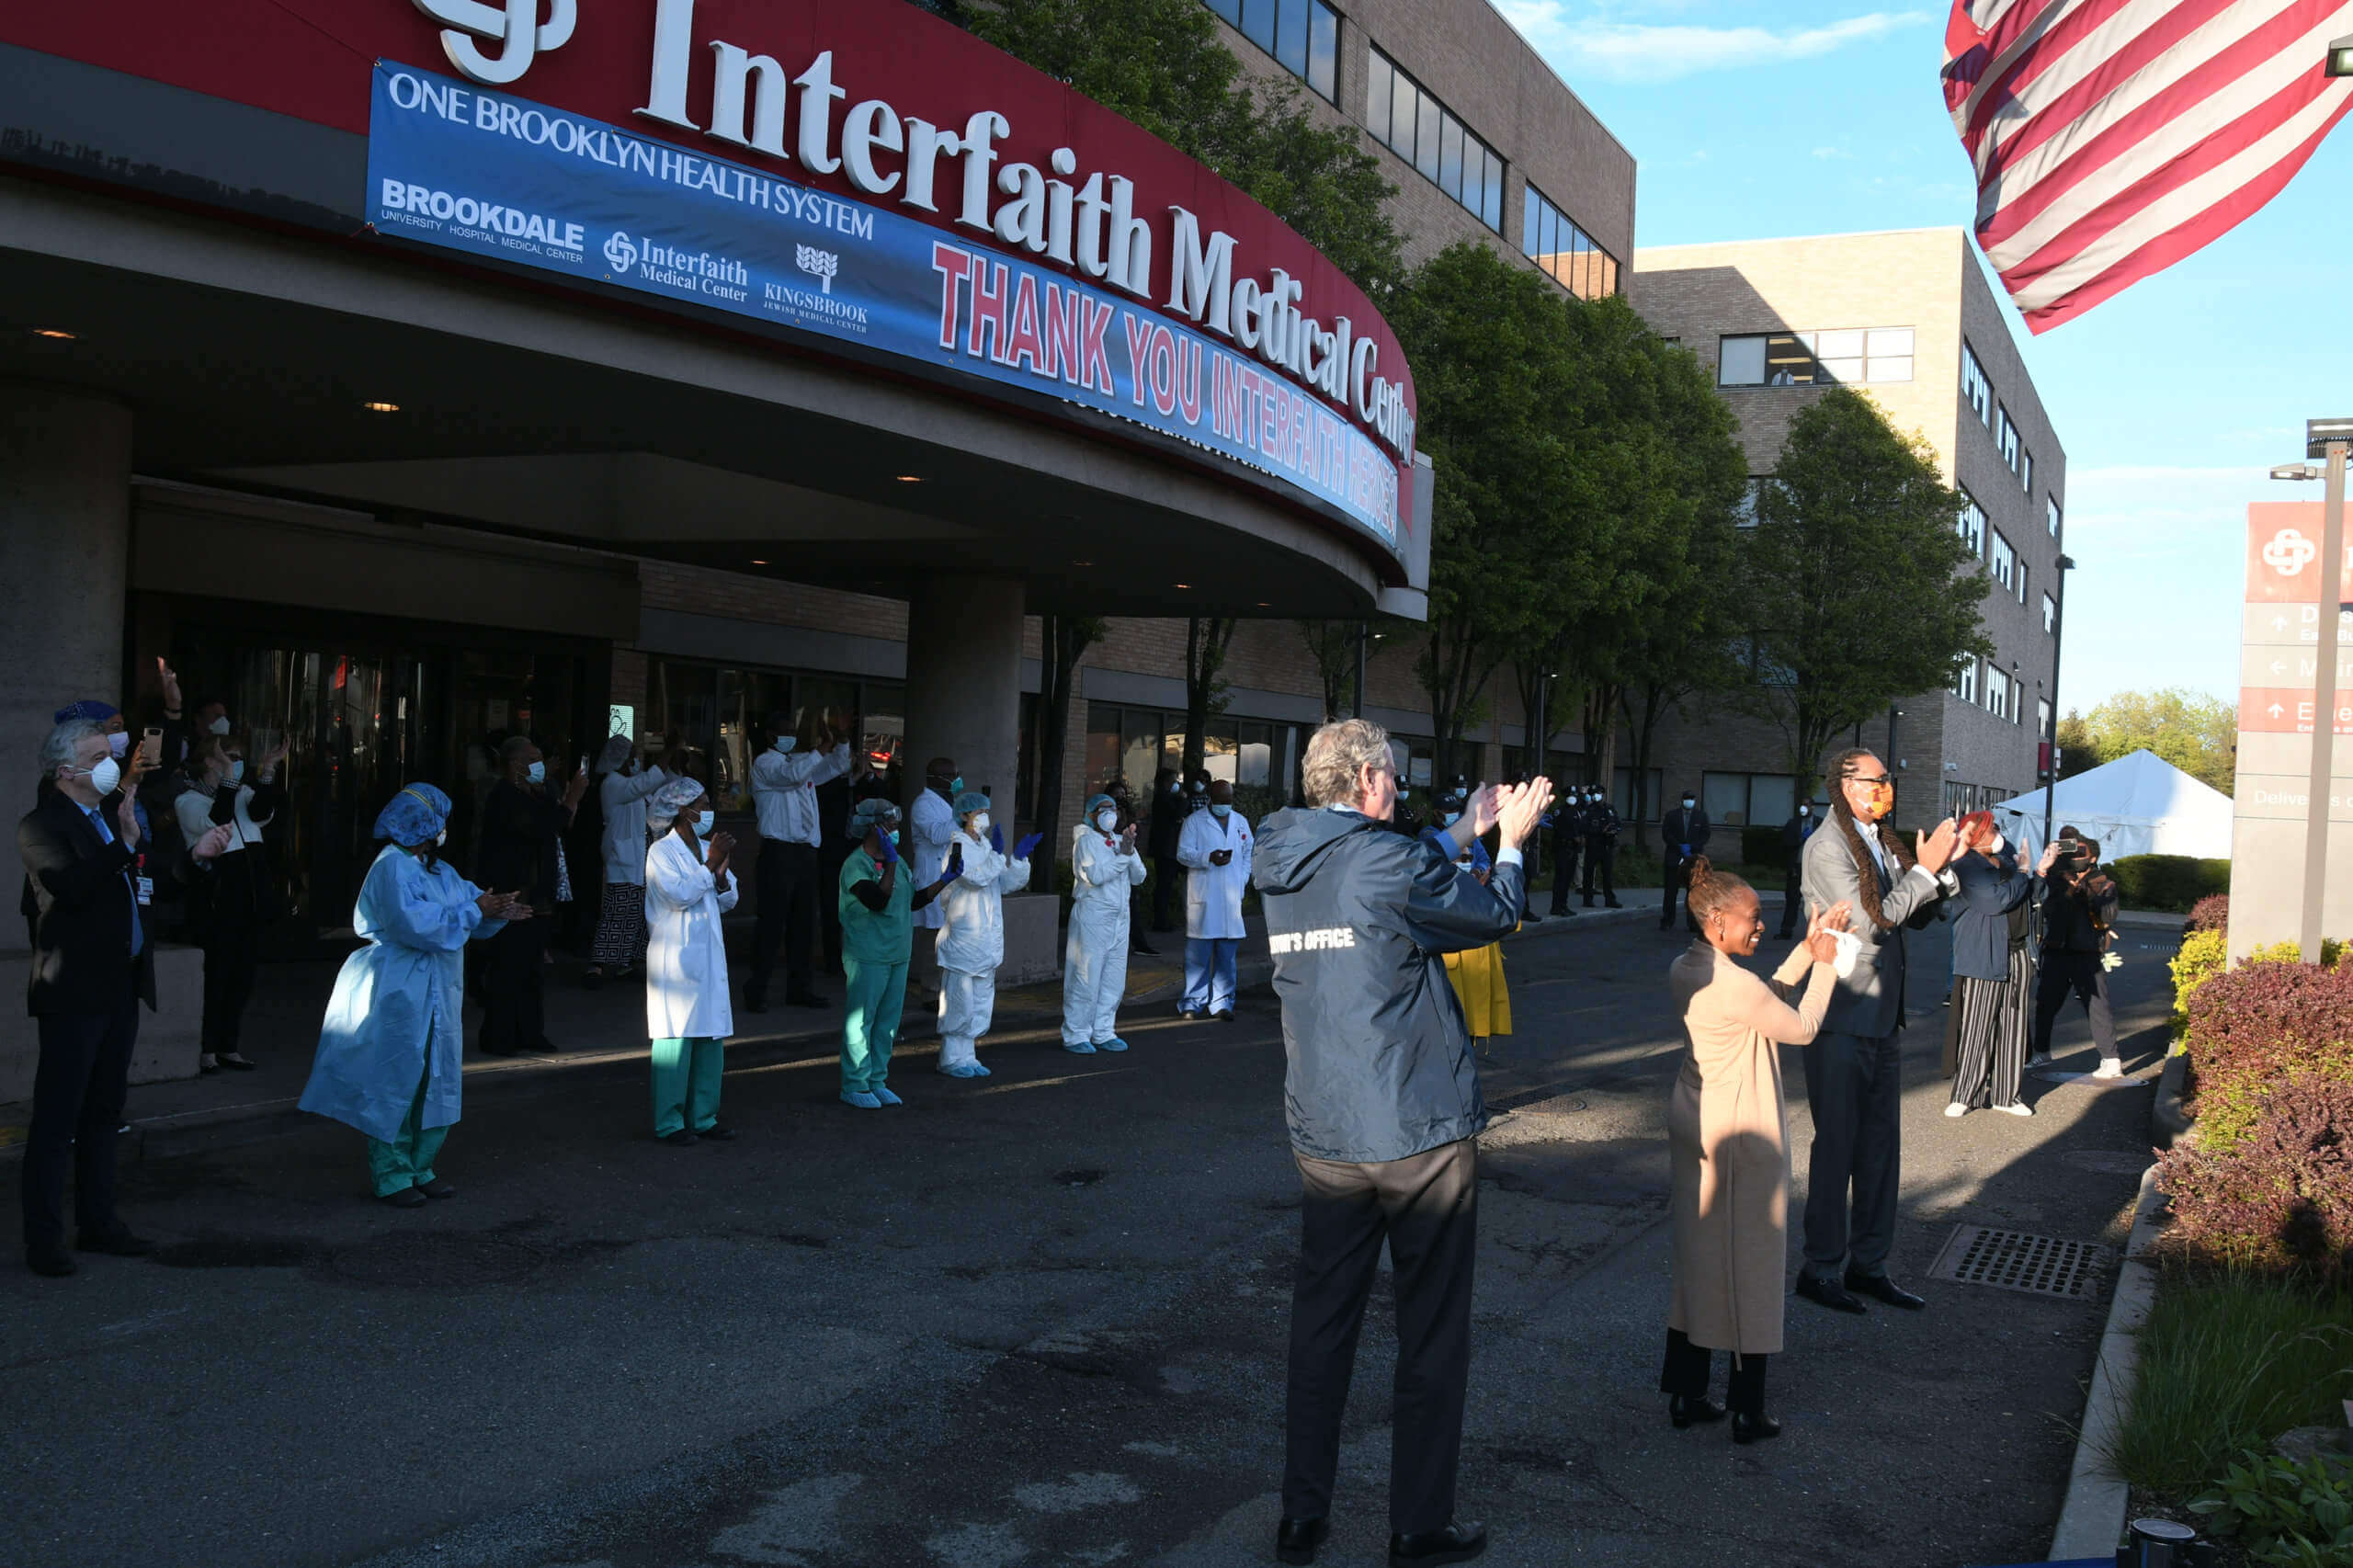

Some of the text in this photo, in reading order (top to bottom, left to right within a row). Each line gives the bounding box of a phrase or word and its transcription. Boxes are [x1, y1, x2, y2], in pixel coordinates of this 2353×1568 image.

[389, 73, 874, 241] ONE BROOKLYN HEALTH SYSTEM
[381, 177, 585, 252] BROOKDALE
[381, 210, 583, 264] UNIVERSITY HOSPITAL MEDICAL CENTER
[632, 0, 1415, 468] Interfaith Medical Center
[640, 263, 748, 302] Medical Center
[641, 236, 748, 287] Interfaith
[764, 281, 869, 324] KINGSBROOK
[764, 301, 867, 334] JEWISH MEDICAL CENTER
[932, 240, 1115, 397] THANK
[1125, 312, 1202, 426] YOU
[1211, 349, 1347, 496] INTERFAITH
[1304, 927, 1355, 950] OFFICE
